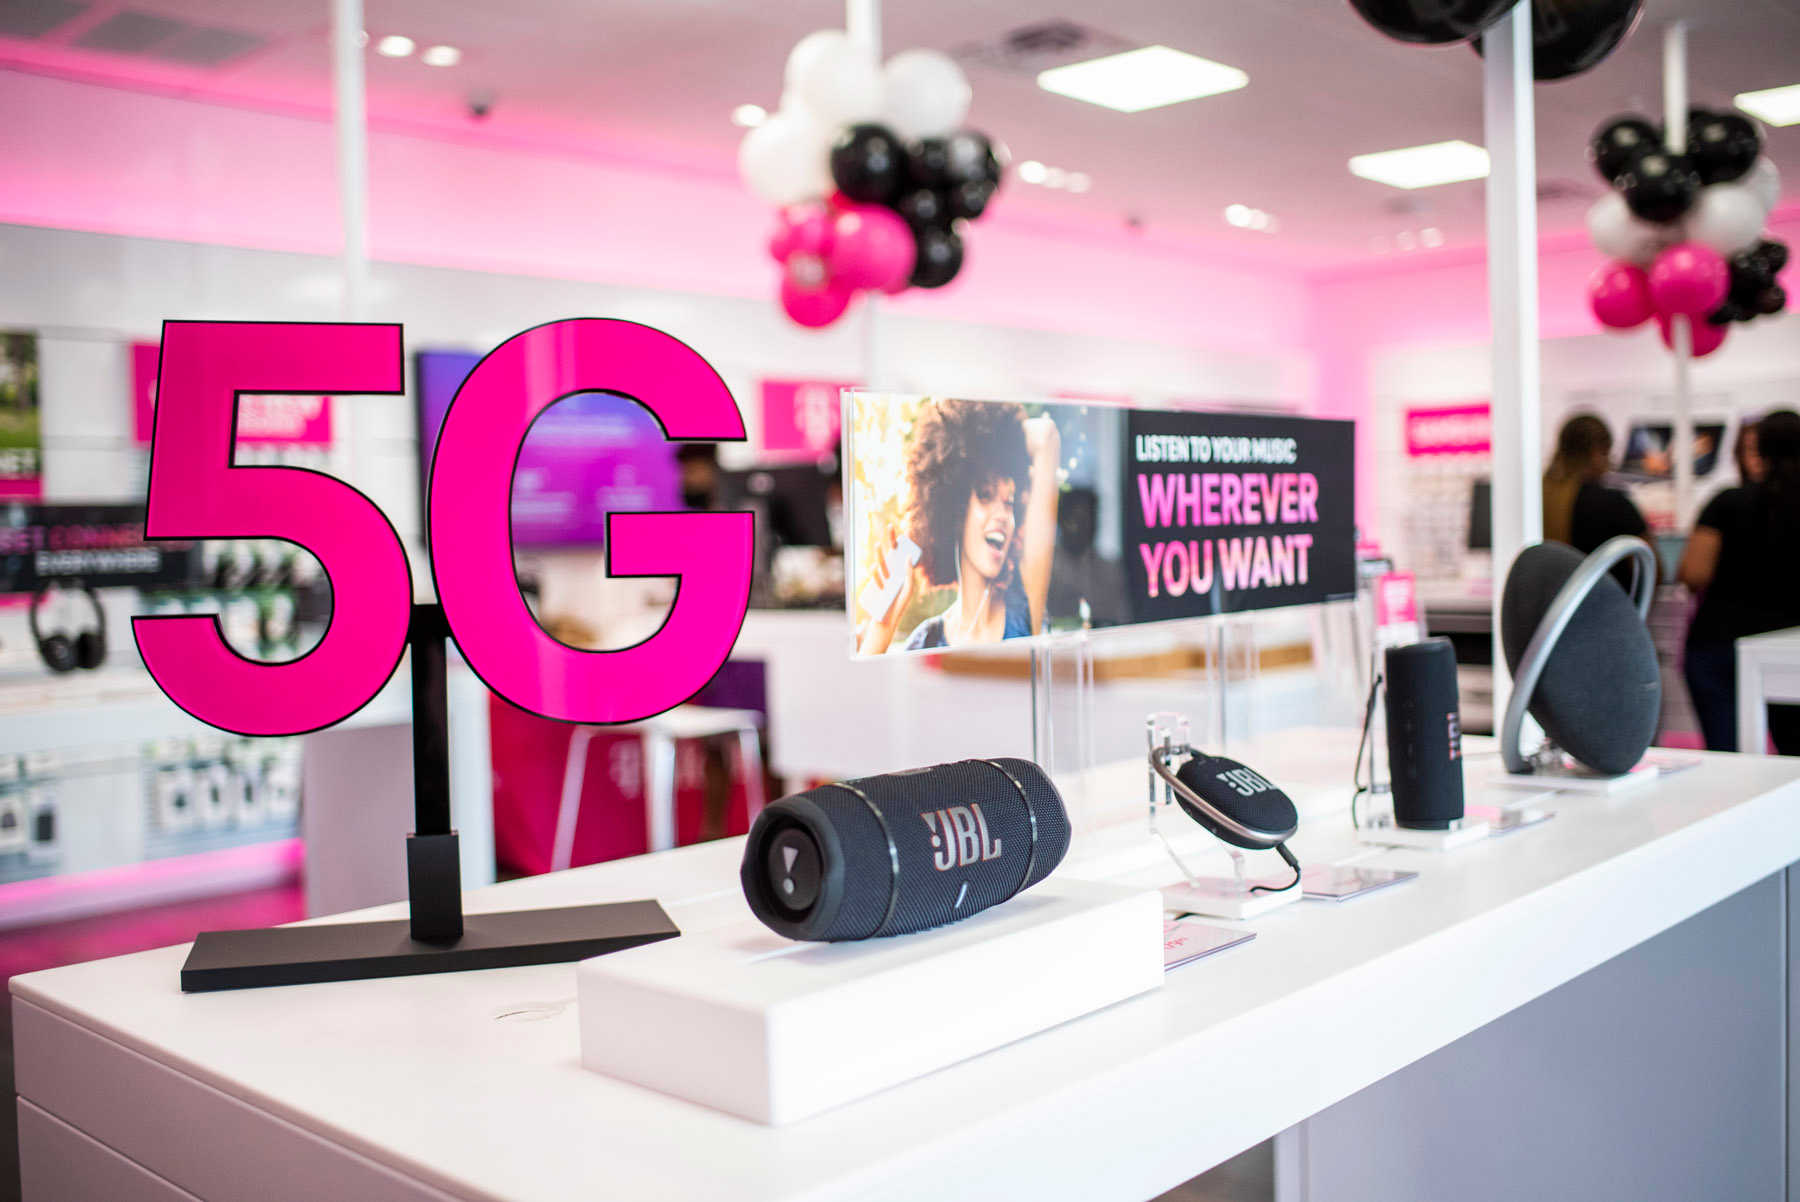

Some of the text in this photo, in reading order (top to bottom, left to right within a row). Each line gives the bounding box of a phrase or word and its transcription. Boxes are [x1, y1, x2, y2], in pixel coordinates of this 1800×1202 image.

[1136, 434, 1297, 465] LISTEN TO YOUR MUSIC
[133, 318, 755, 737] 5G
[1138, 473, 1319, 528] WHEREVER
[1139, 534, 1313, 597] YOU WANT
[1219, 766, 1277, 797] JBL
[922, 803, 1002, 871] JBL
